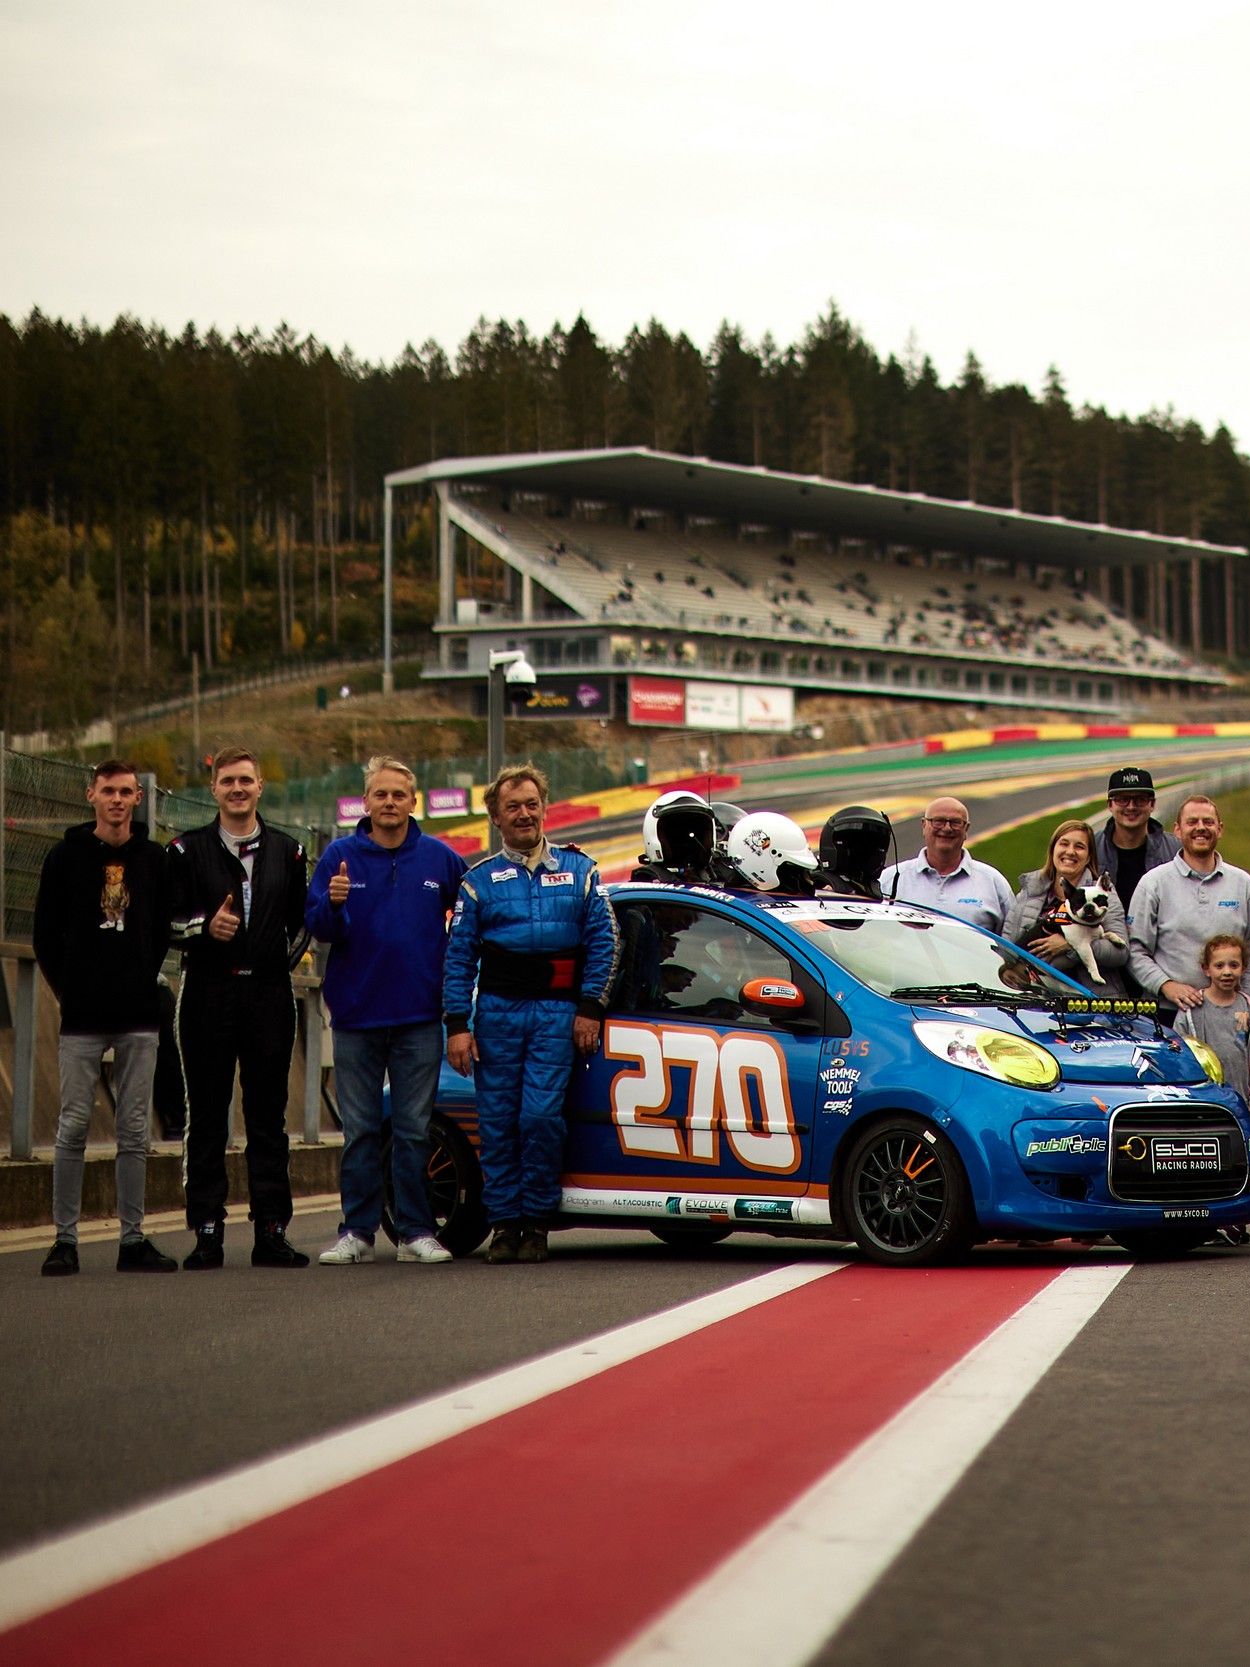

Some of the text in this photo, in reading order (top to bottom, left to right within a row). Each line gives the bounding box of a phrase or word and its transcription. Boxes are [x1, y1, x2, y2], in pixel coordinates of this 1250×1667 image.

[545, 874, 569, 883] TNT
[820, 1067, 861, 1082] WEMMEL
[827, 1081, 853, 1094] TOOLS
[605, 1021, 800, 1174] 270
[1155, 1142, 1217, 1156] SYCO
[1156, 1160, 1218, 1171] RACING RADIOS
[686, 1199, 728, 1209] EVOLVE
[1164, 1209, 1210, 1218] WWW.SYCO.EU
